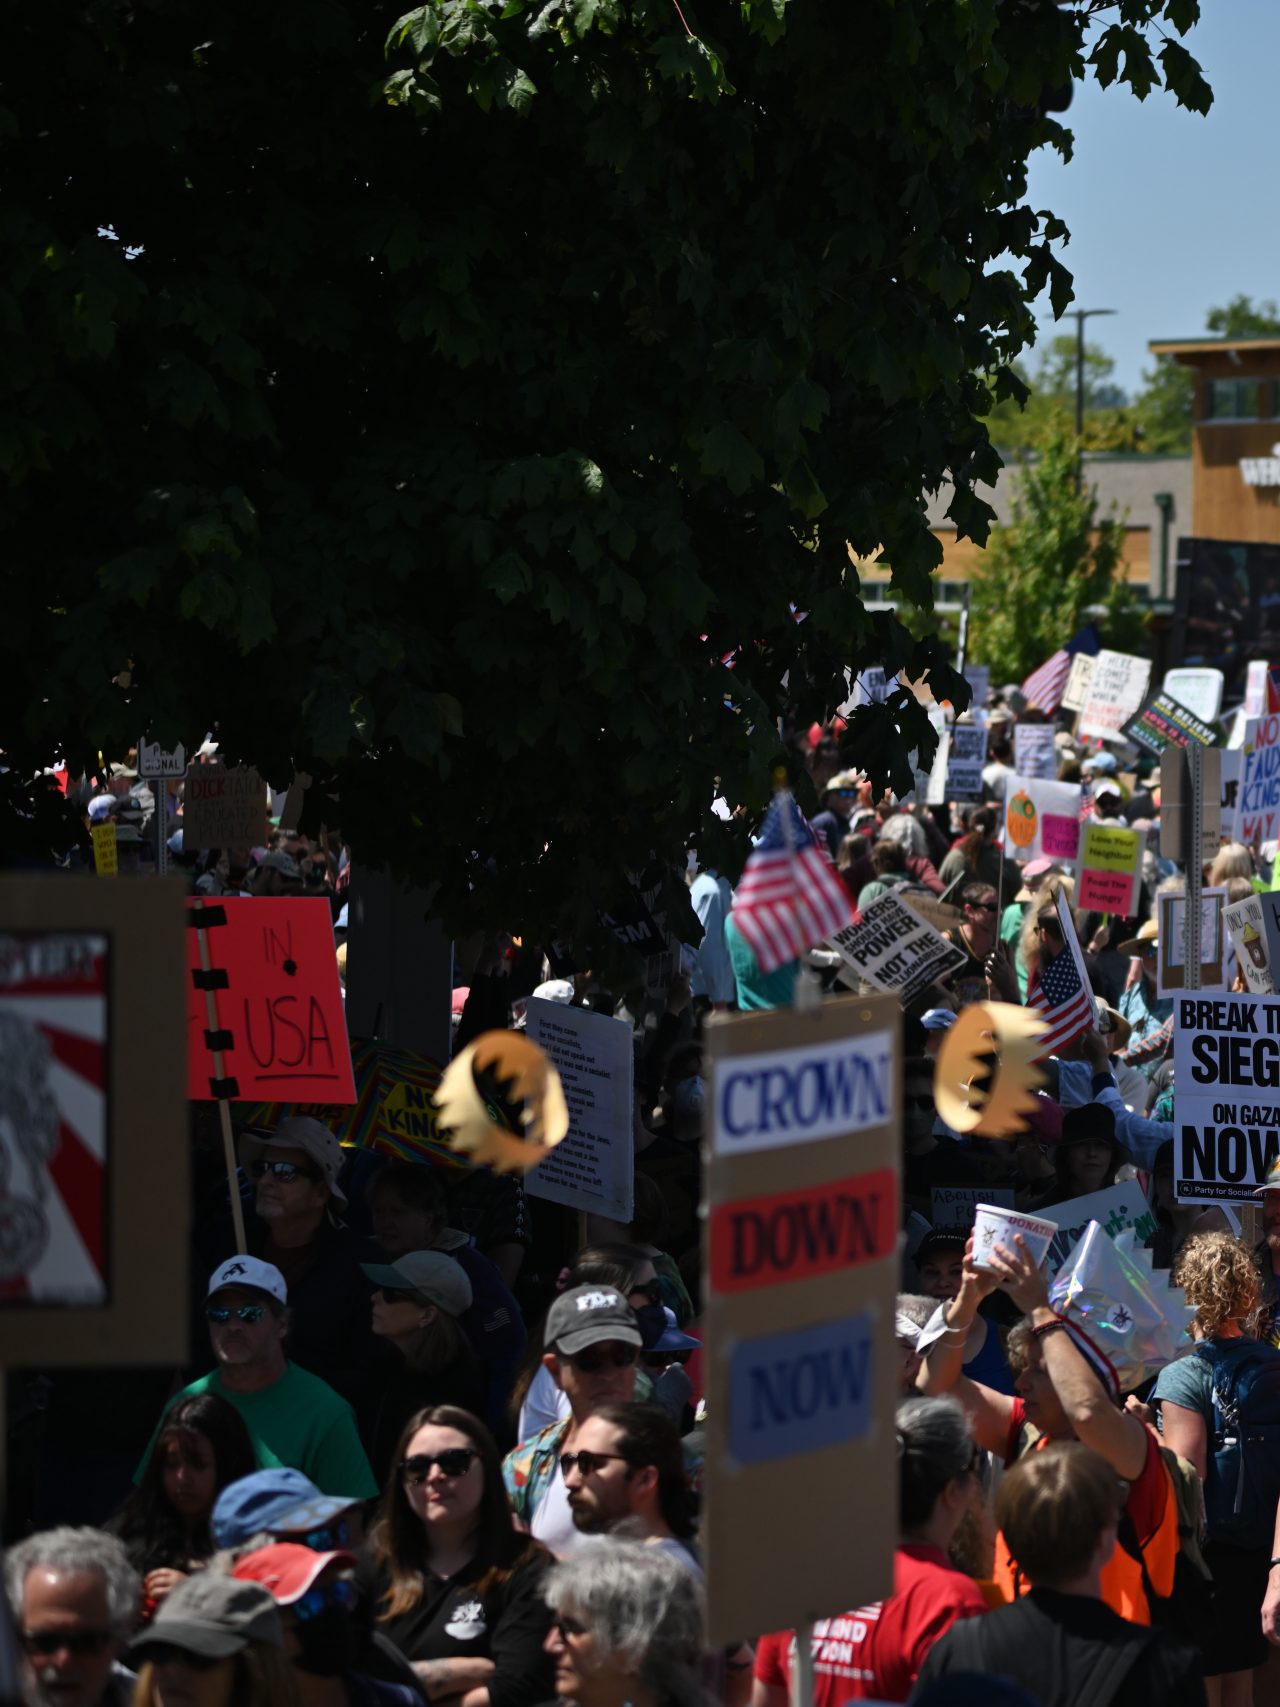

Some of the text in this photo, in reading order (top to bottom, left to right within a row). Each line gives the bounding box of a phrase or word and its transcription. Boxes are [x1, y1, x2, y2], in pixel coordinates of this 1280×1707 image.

[1175, 707, 1217, 742] BELIEVE
[1255, 716, 1280, 748] NO
[144, 758, 180, 770] SIGNAL
[1010, 798, 1036, 819] NO
[1091, 833, 1135, 846] Love Your
[1242, 813, 1276, 840] WAY
[1089, 847, 1133, 860] Neighbor
[1088, 891, 1124, 905] Hungry
[1111, 880, 1128, 890] The
[833, 896, 899, 946] WORKERS
[844, 905, 908, 955] SHOULD HAVE
[1226, 903, 1263, 932] ONLY YOU
[263, 920, 293, 965] IN
[852, 914, 921, 968] POWER
[874, 932, 940, 985] NOT THE
[244, 996, 335, 1069] USA
[1180, 1000, 1259, 1033] BREAK
[722, 1052, 893, 1139] CROWN
[1213, 1103, 1237, 1125] ON
[934, 1190, 995, 1203] ABOLISH
[1195, 1186, 1215, 1196] Party
[1216, 1187, 1227, 1195] for
[729, 1192, 882, 1280] DOWN
[749, 1338, 873, 1432] NOW
